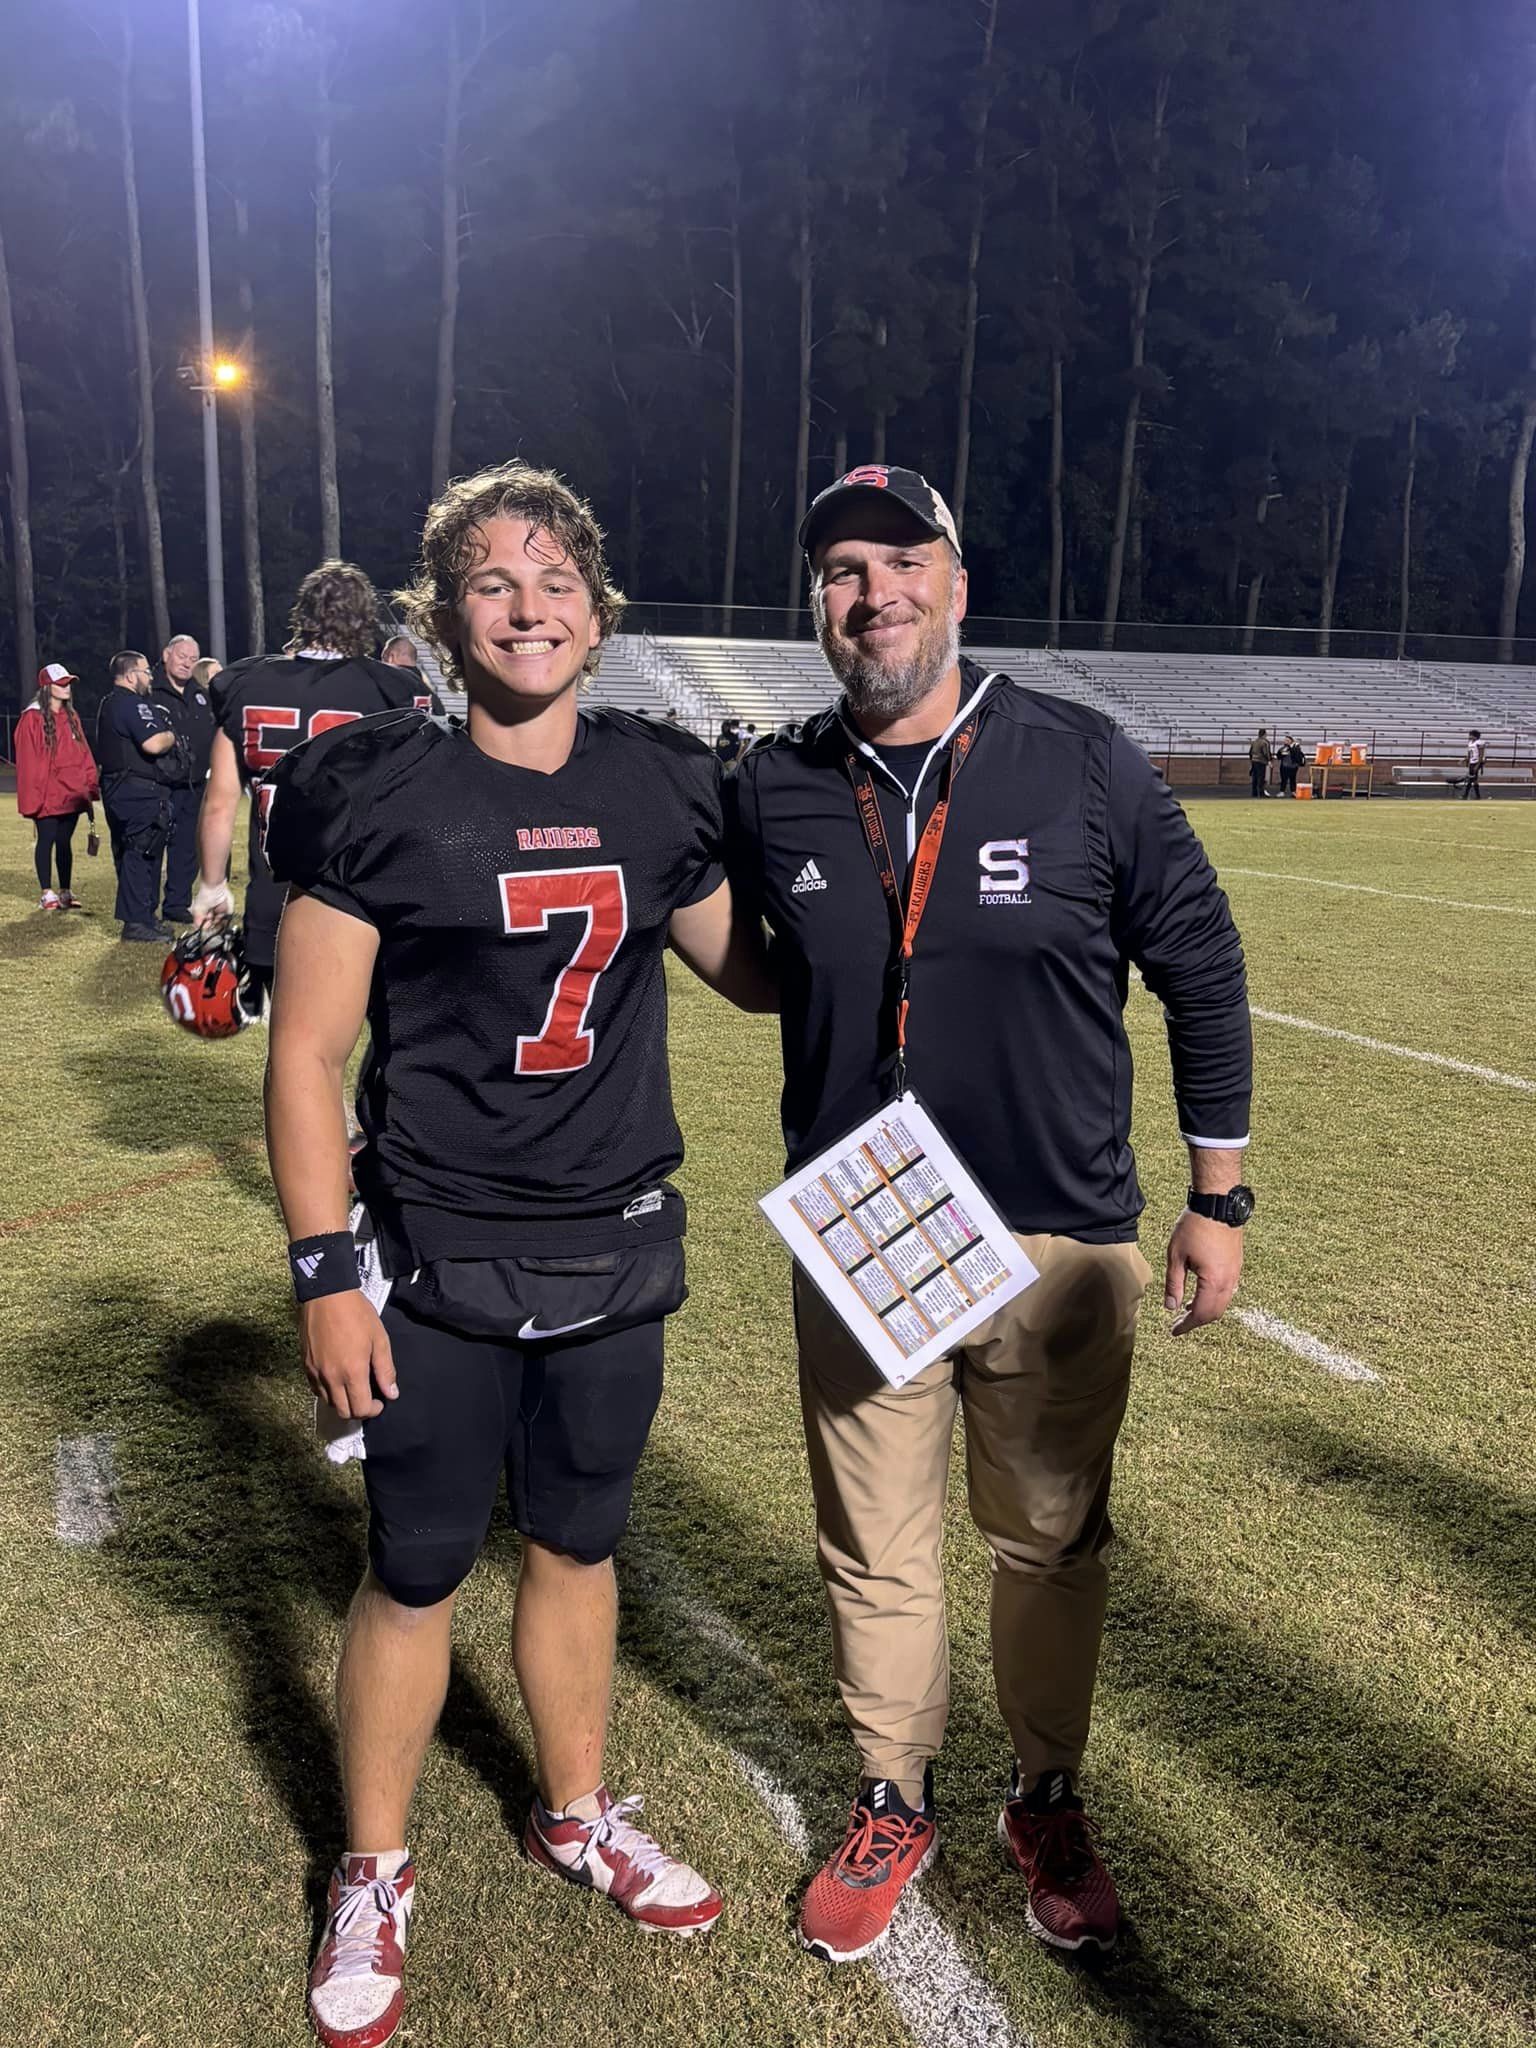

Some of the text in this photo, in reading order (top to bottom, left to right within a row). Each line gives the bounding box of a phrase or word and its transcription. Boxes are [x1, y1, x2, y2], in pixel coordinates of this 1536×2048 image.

[844, 465, 888, 488] S
[243, 706, 364, 771] 5
[516, 827, 600, 850] RAIDERS
[979, 839, 1029, 891] S
[792, 879, 827, 893] adidas
[912, 861, 931, 907] RAIDERS
[979, 894, 1031, 904] FOOTBALL
[498, 865, 628, 1075] 7
